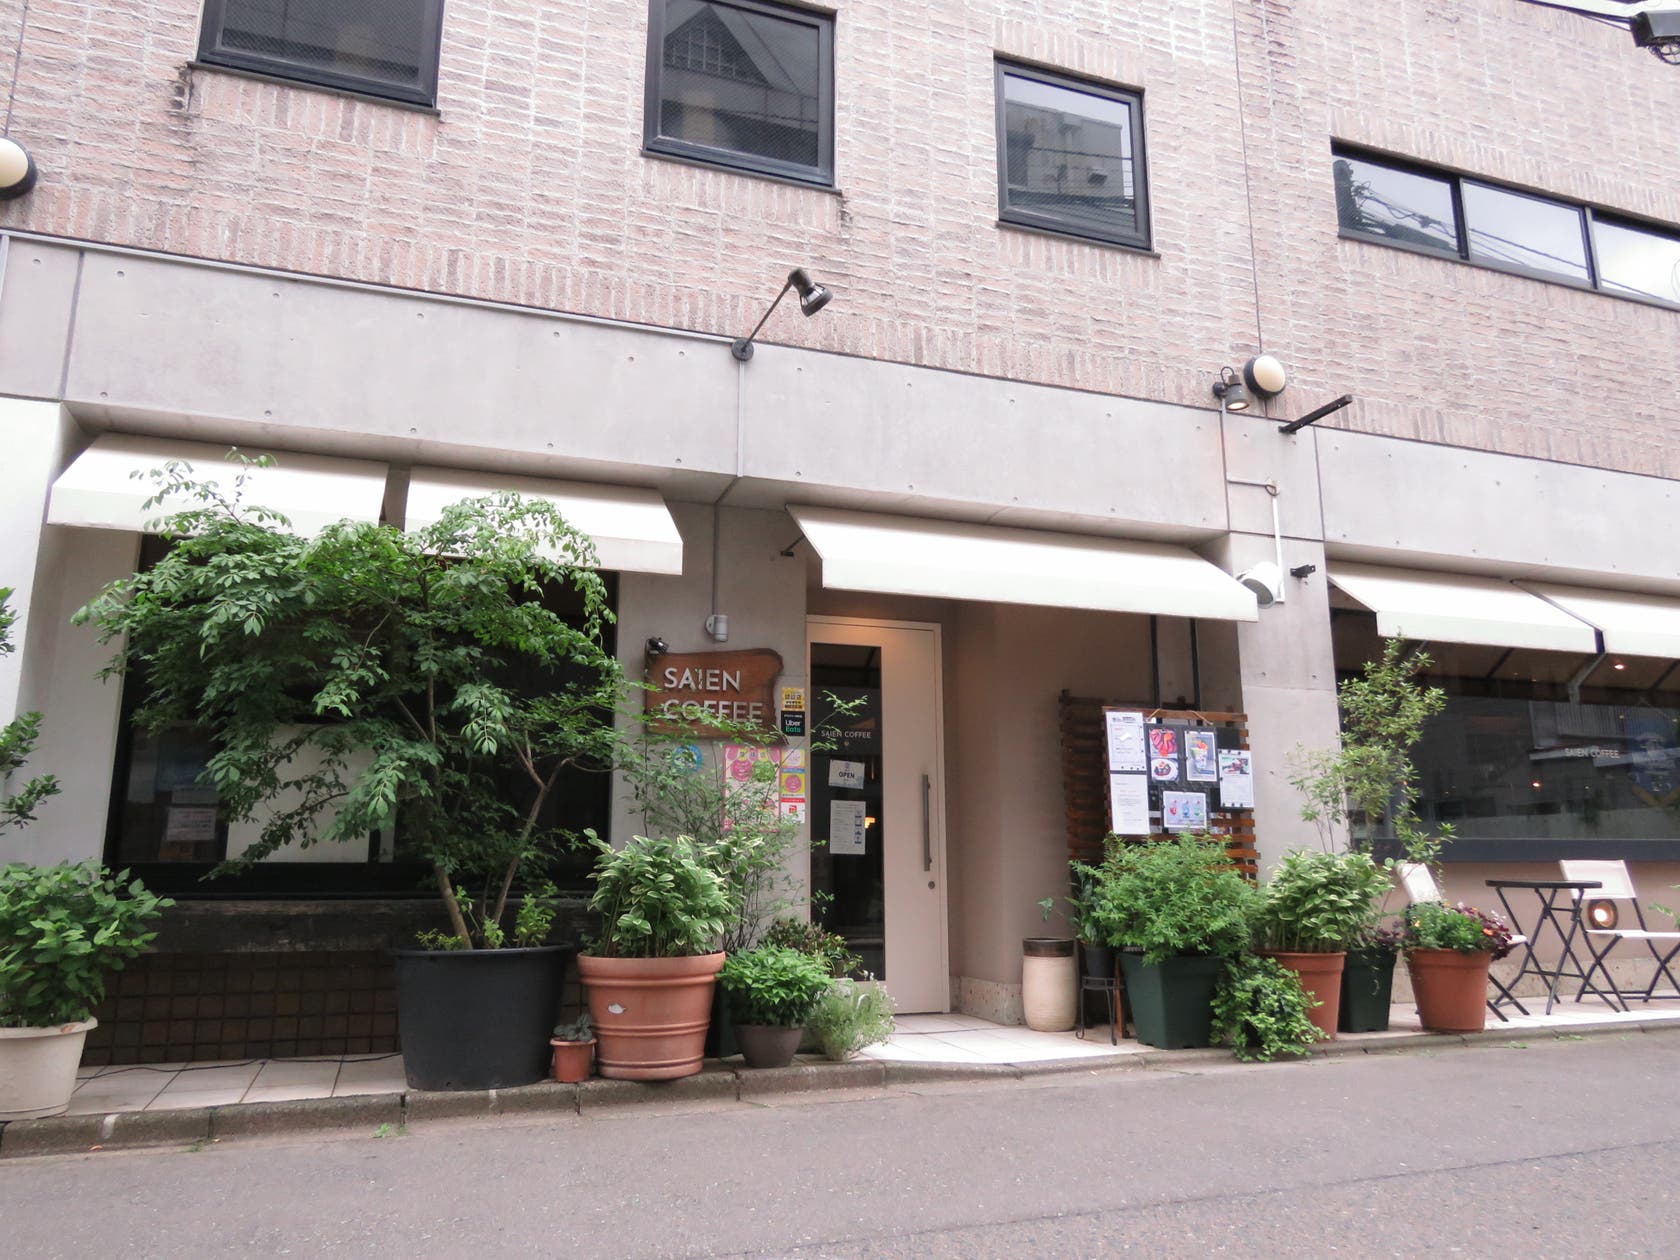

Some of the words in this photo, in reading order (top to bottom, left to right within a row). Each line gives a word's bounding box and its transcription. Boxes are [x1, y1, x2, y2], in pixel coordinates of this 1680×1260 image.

[664, 667, 741, 692] SAIEN
[663, 699, 763, 723] COFFEE
[785, 719, 801, 727] Uber
[844, 730, 871, 738] COFFEE
[1590, 748, 1620, 759] COFFEE
[838, 771, 855, 779] OPEN
